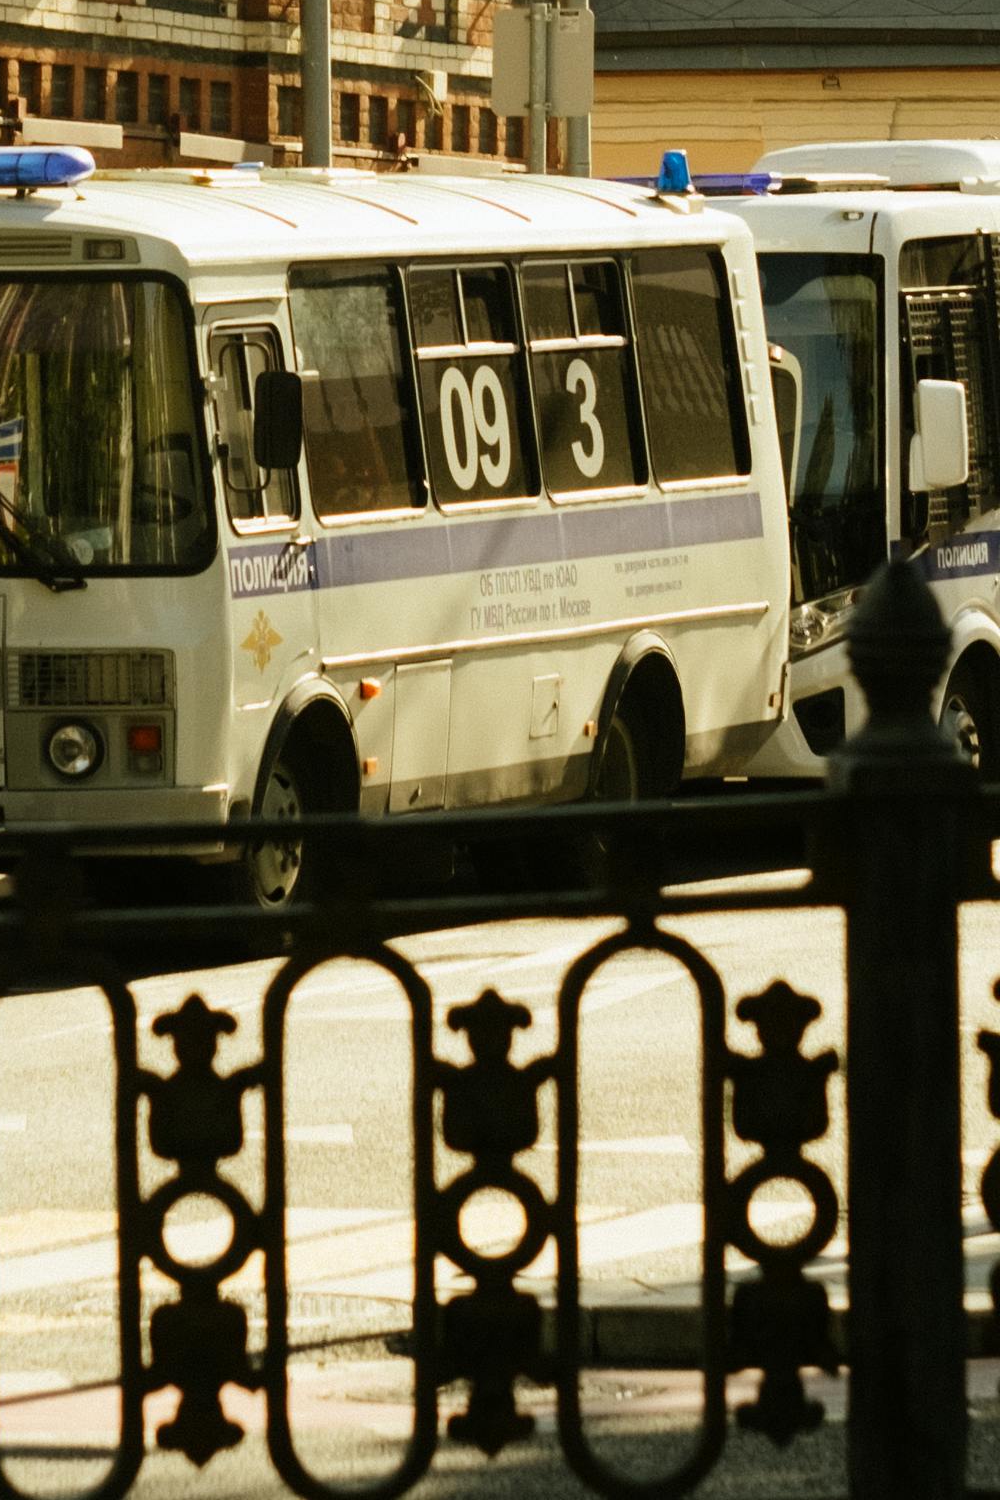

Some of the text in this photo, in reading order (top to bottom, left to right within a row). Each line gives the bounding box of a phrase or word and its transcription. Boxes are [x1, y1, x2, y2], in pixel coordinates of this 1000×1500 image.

[438, 357, 605, 492] 09 3
[230, 551, 309, 593] ПОЛИЦИЯ
[937, 541, 989, 568] ПОЛИЦИЯ
[479, 564, 578, 597] ОБ ППСП УВД по ЮАО
[470, 607, 482, 631] ГУ
[483, 603, 505, 631] МВД
[505, 603, 537, 625] России
[539, 603, 551, 621] по
[559, 596, 592, 619] Москве
